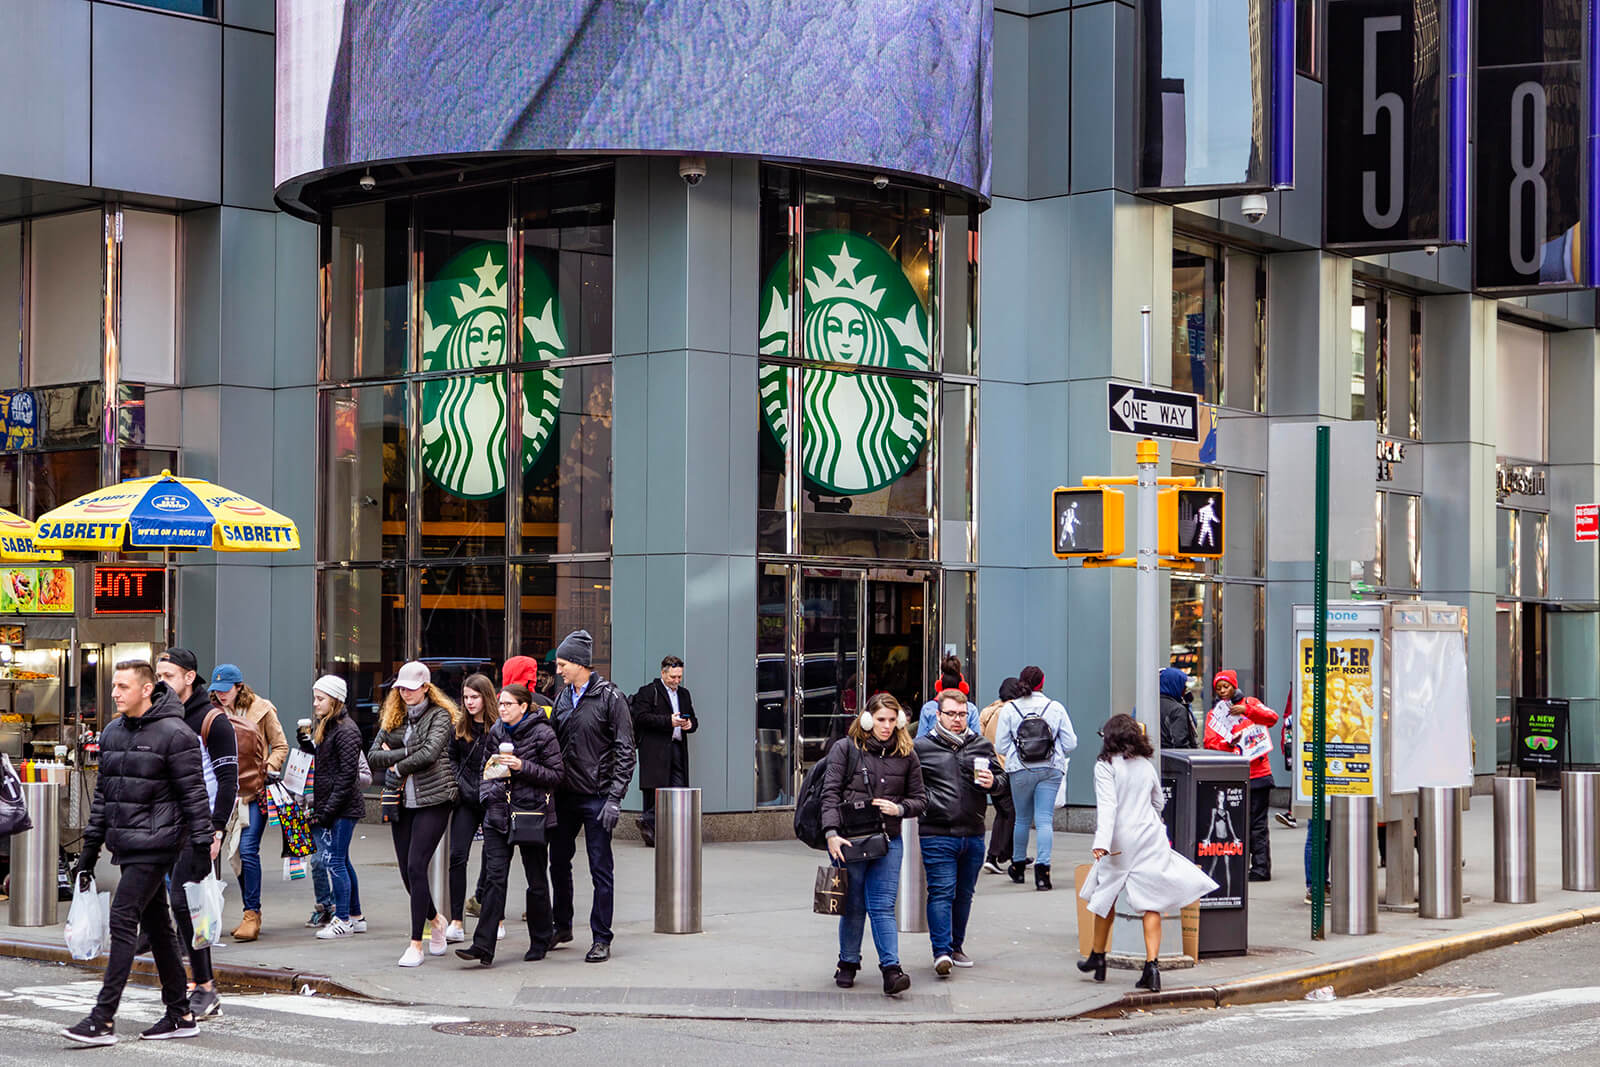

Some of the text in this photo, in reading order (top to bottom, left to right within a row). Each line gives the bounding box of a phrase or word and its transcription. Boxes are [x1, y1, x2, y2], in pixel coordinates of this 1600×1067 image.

[1362, 16, 1405, 230] 5
[1509, 81, 1548, 276] 8
[1122, 400, 1187, 425] ONE WAY
[38, 523, 121, 539] SABRETT
[179, 529, 195, 537] ROLL
[223, 525, 292, 542] SABRETT
[1327, 611, 1358, 620] hone
[1343, 666, 1369, 674] ROOF
[1529, 714, 1536, 722] A
[1197, 841, 1243, 857] CHICAGO
[830, 898, 838, 913] R
